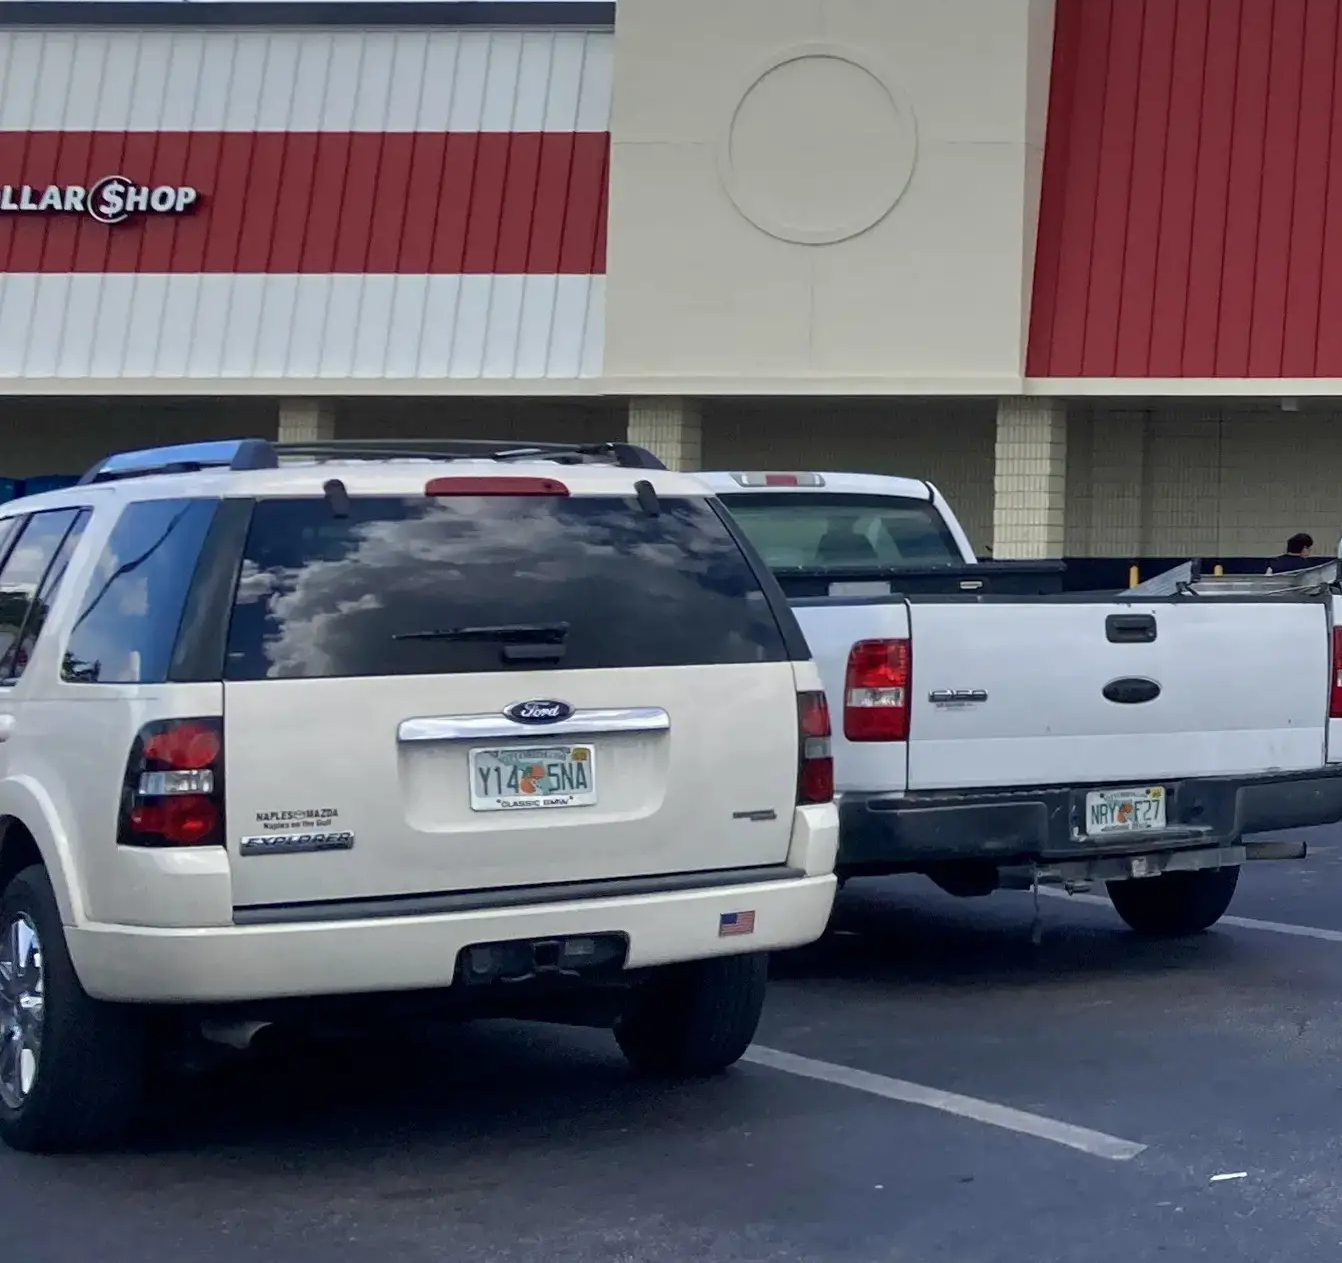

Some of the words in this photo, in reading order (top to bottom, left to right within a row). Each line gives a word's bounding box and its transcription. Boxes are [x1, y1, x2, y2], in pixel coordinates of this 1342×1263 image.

[0, 184, 85, 211] LLAR
[521, 701, 560, 717] Ford
[256, 811, 293, 822] NAPLES
[306, 808, 339, 818] MAZDA
[245, 832, 352, 847] EXPLORER
